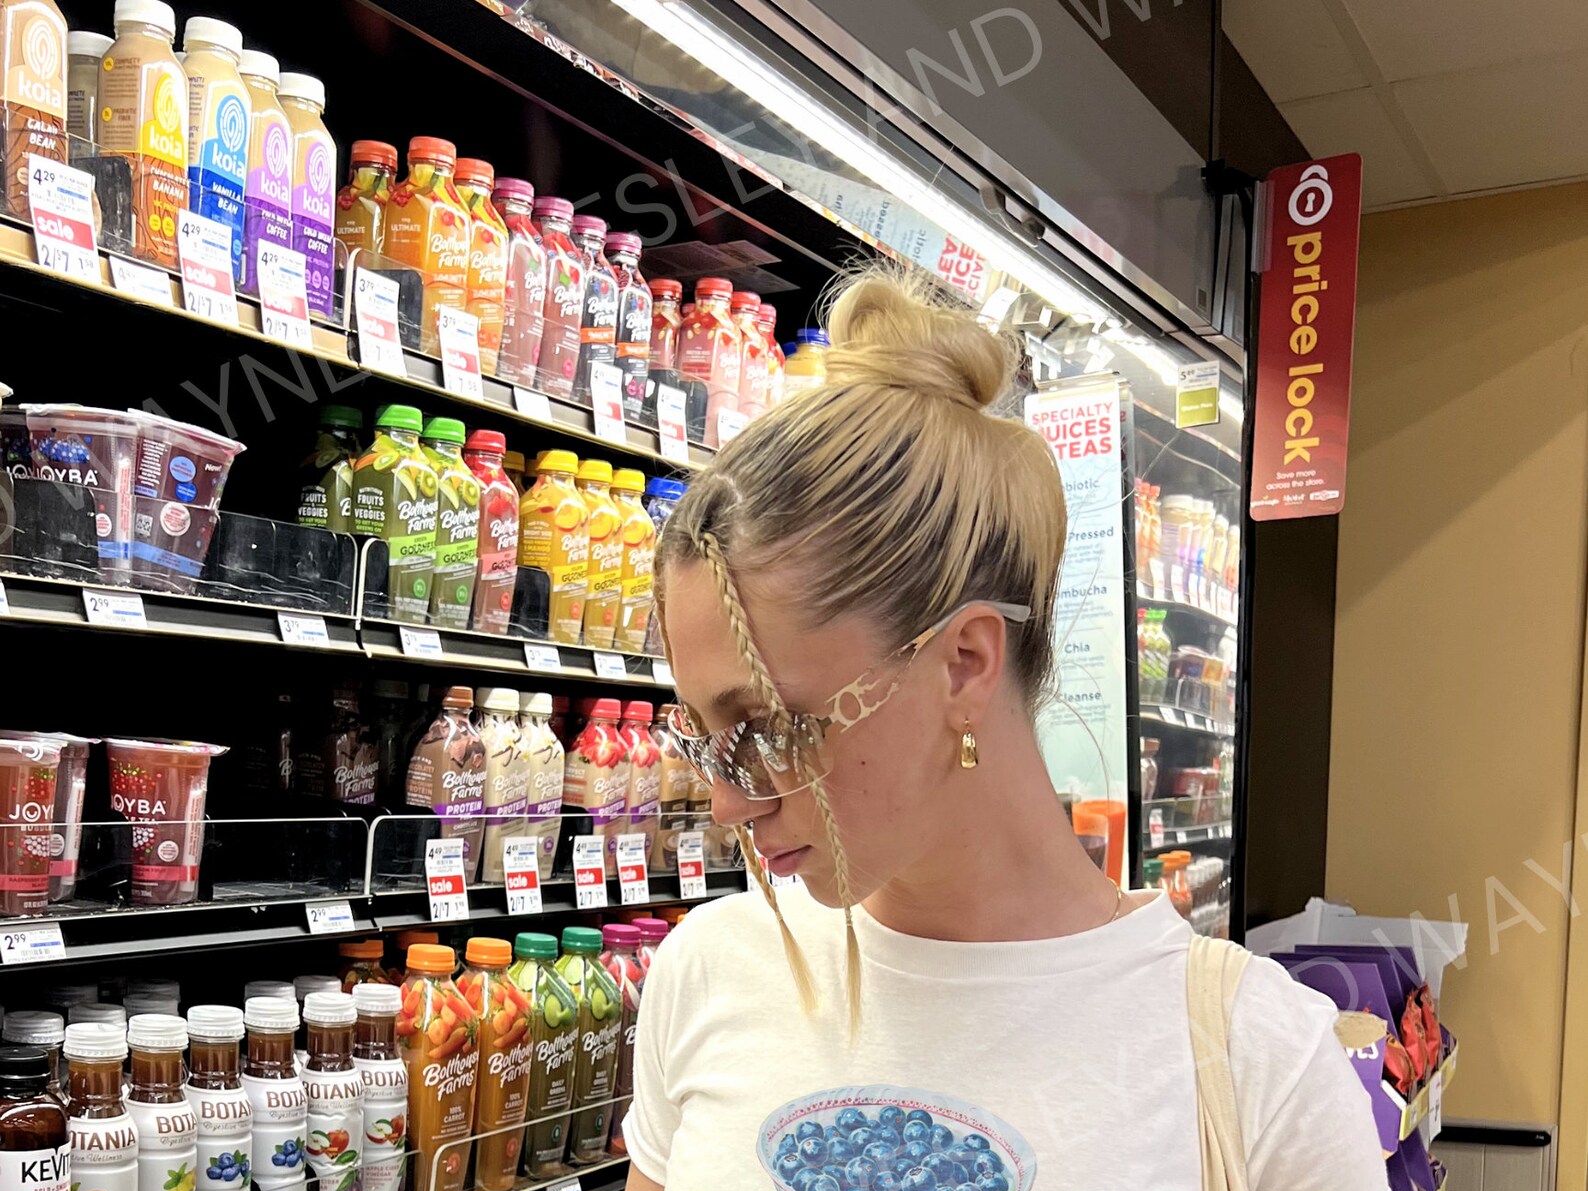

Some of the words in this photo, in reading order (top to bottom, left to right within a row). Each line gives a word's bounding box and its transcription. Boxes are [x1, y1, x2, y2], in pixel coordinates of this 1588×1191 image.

[19, 71, 62, 109] koia
[30, 133, 55, 150] BEAN
[149, 126, 183, 158] koia
[212, 143, 245, 180] koia
[153, 180, 184, 200] BANANA
[261, 171, 289, 203] koia
[217, 200, 238, 215] BEAN
[303, 188, 330, 219] koia
[37, 217, 73, 241] sale
[266, 224, 287, 240] COFFEE
[337, 226, 365, 235] ULTIMATE
[391, 224, 421, 232] ULTIMATE
[1287, 231, 1328, 356] price
[1032, 402, 1114, 426] SPECIALTY
[1283, 362, 1324, 466] lock
[1055, 439, 1113, 461] TEAS
[1276, 472, 1294, 480] Save
[358, 495, 384, 506] FRUITS
[298, 508, 328, 517] VEGGIES
[354, 508, 385, 520] VEGGIES
[1064, 642, 1090, 655] Chia
[345, 776, 375, 796] Farms
[451, 786, 483, 801] Farms
[111, 794, 166, 815] OYBA
[446, 801, 482, 815] PROTEIN
[577, 871, 595, 884] sale
[622, 868, 637, 880] sale
[681, 865, 695, 876] sale
[431, 878, 453, 894] sale
[508, 875, 528, 888] sale
[4, 933, 26, 950] 299
[546, 1046, 574, 1075] Farms
[438, 1070, 475, 1101] Farms
[505, 1099, 524, 1109] CARROT
[444, 1112, 466, 1123] CARROT
[21, 1152, 70, 1183] KEVIT
